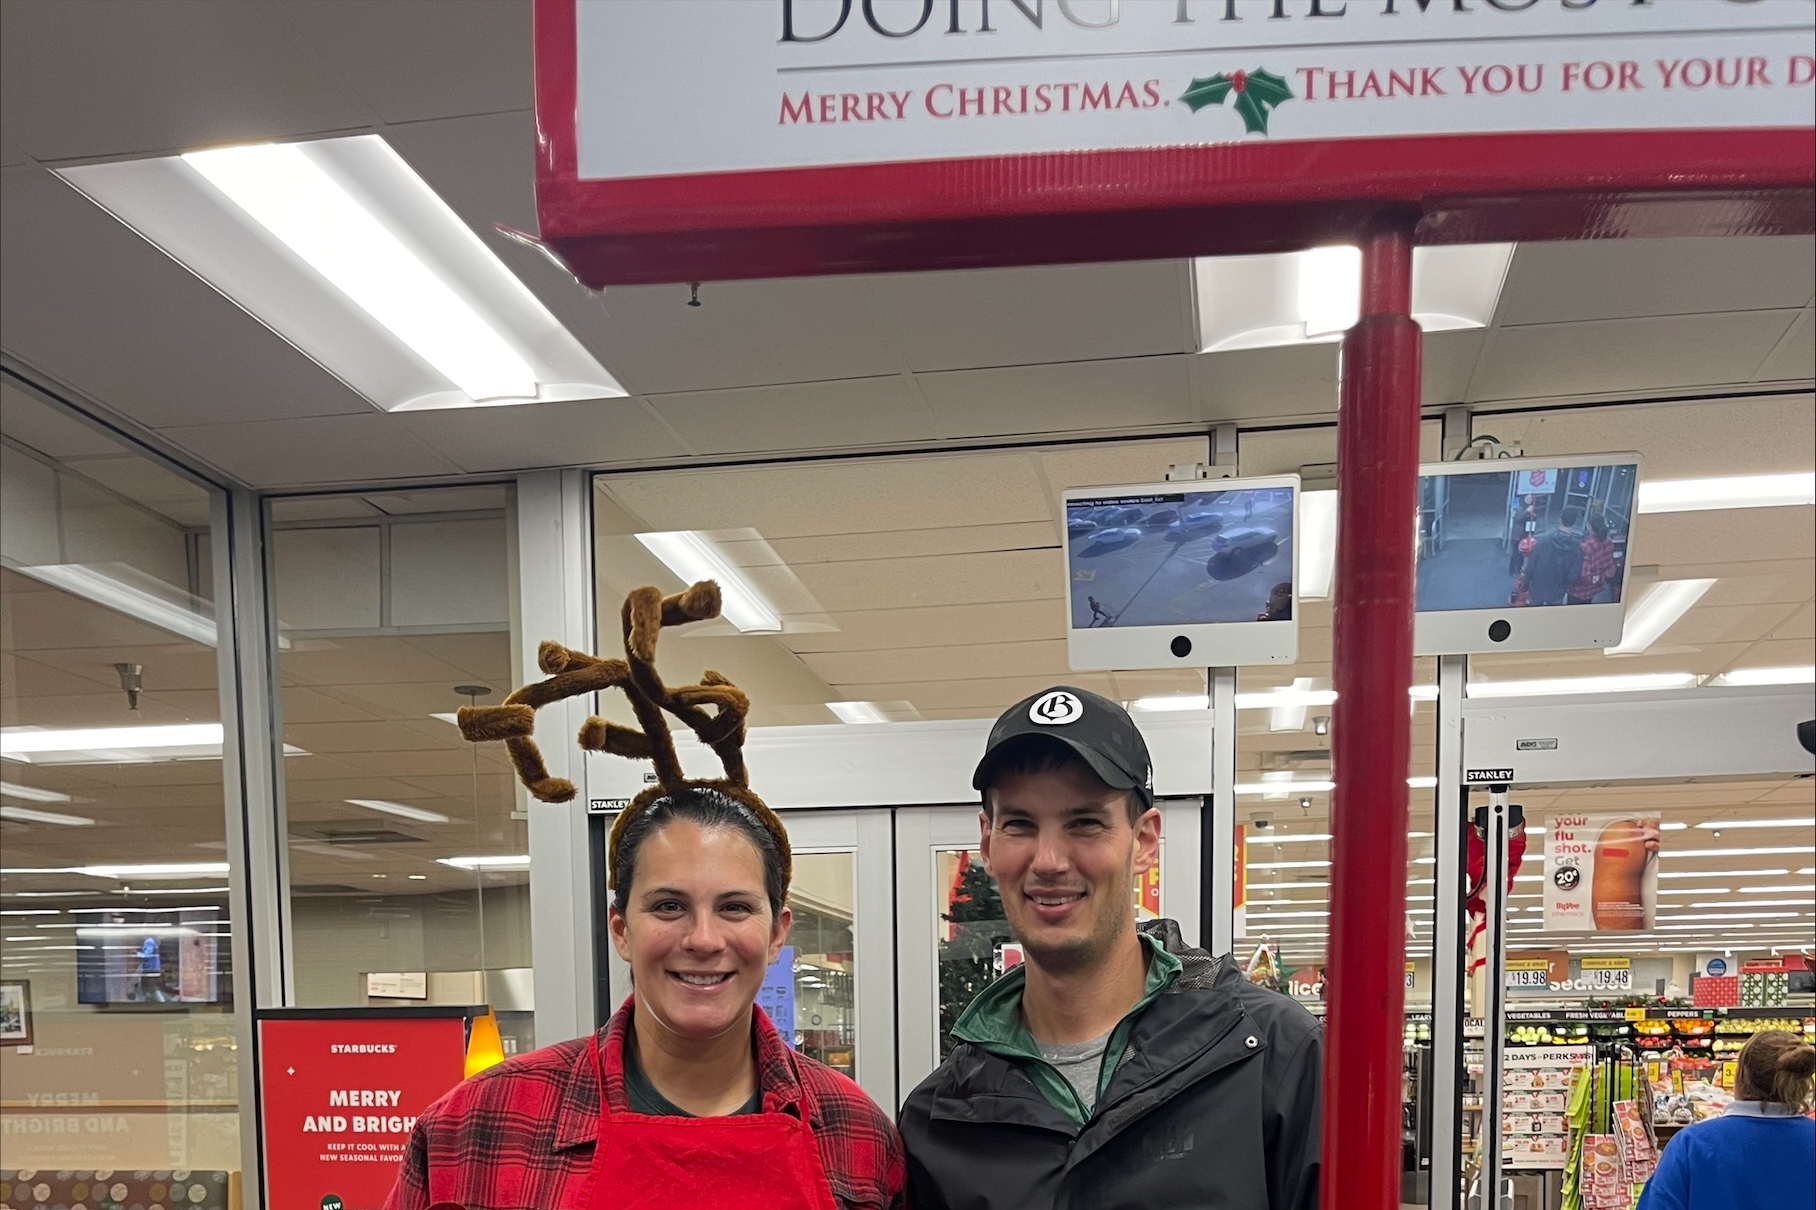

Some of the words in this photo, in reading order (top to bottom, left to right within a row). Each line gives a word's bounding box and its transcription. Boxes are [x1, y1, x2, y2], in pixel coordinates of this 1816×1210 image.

[1296, 66, 1447, 101] THANK
[1456, 63, 1546, 95] YOU
[1561, 60, 1643, 92] FOR
[1656, 56, 1772, 90] YOUR
[777, 89, 912, 126] MERRY
[1468, 771, 1512, 780] STANLEY
[592, 801, 630, 809] STANLEY
[1554, 817, 1588, 829] your
[1554, 831, 1574, 841] flu
[1554, 843, 1591, 853] shot.
[1555, 856, 1580, 866] Get
[330, 1044, 395, 1053] STARBUCKS
[329, 1090, 401, 1107] MERRY
[303, 1116, 347, 1132] AND
[352, 1116, 418, 1133] BRIGH
[327, 1143, 346, 1151] KEEP
[348, 1143, 355, 1151] IT
[356, 1143, 377, 1151] COOL
[379, 1143, 399, 1151] WITH
[339, 1154, 378, 1162] SEASONAL
[322, 1202, 341, 1210] NEW
